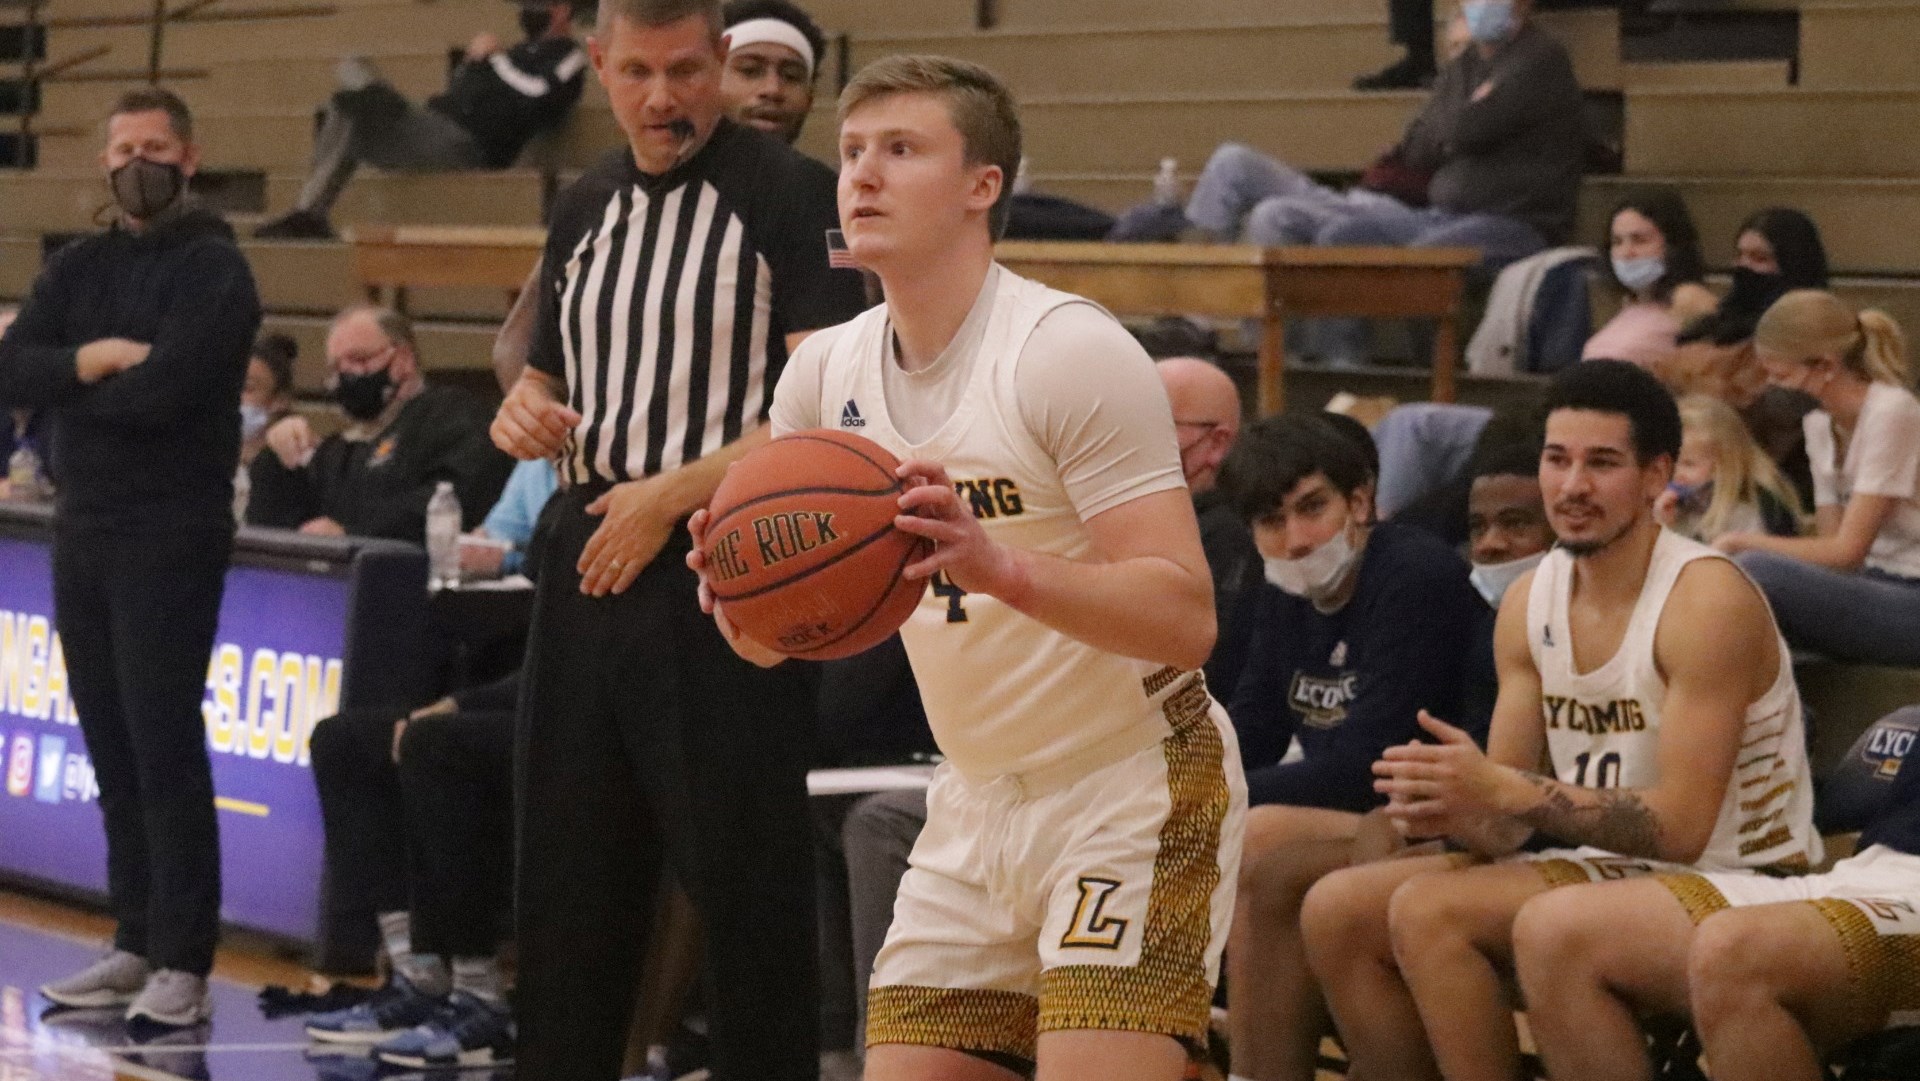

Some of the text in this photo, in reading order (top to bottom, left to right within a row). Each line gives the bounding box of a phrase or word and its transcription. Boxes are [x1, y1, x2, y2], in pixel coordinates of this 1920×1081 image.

[752, 511, 840, 568] ROCK
[201, 642, 344, 768] S.COM
[1575, 752, 1621, 788] 10
[1059, 876, 1128, 950] L
